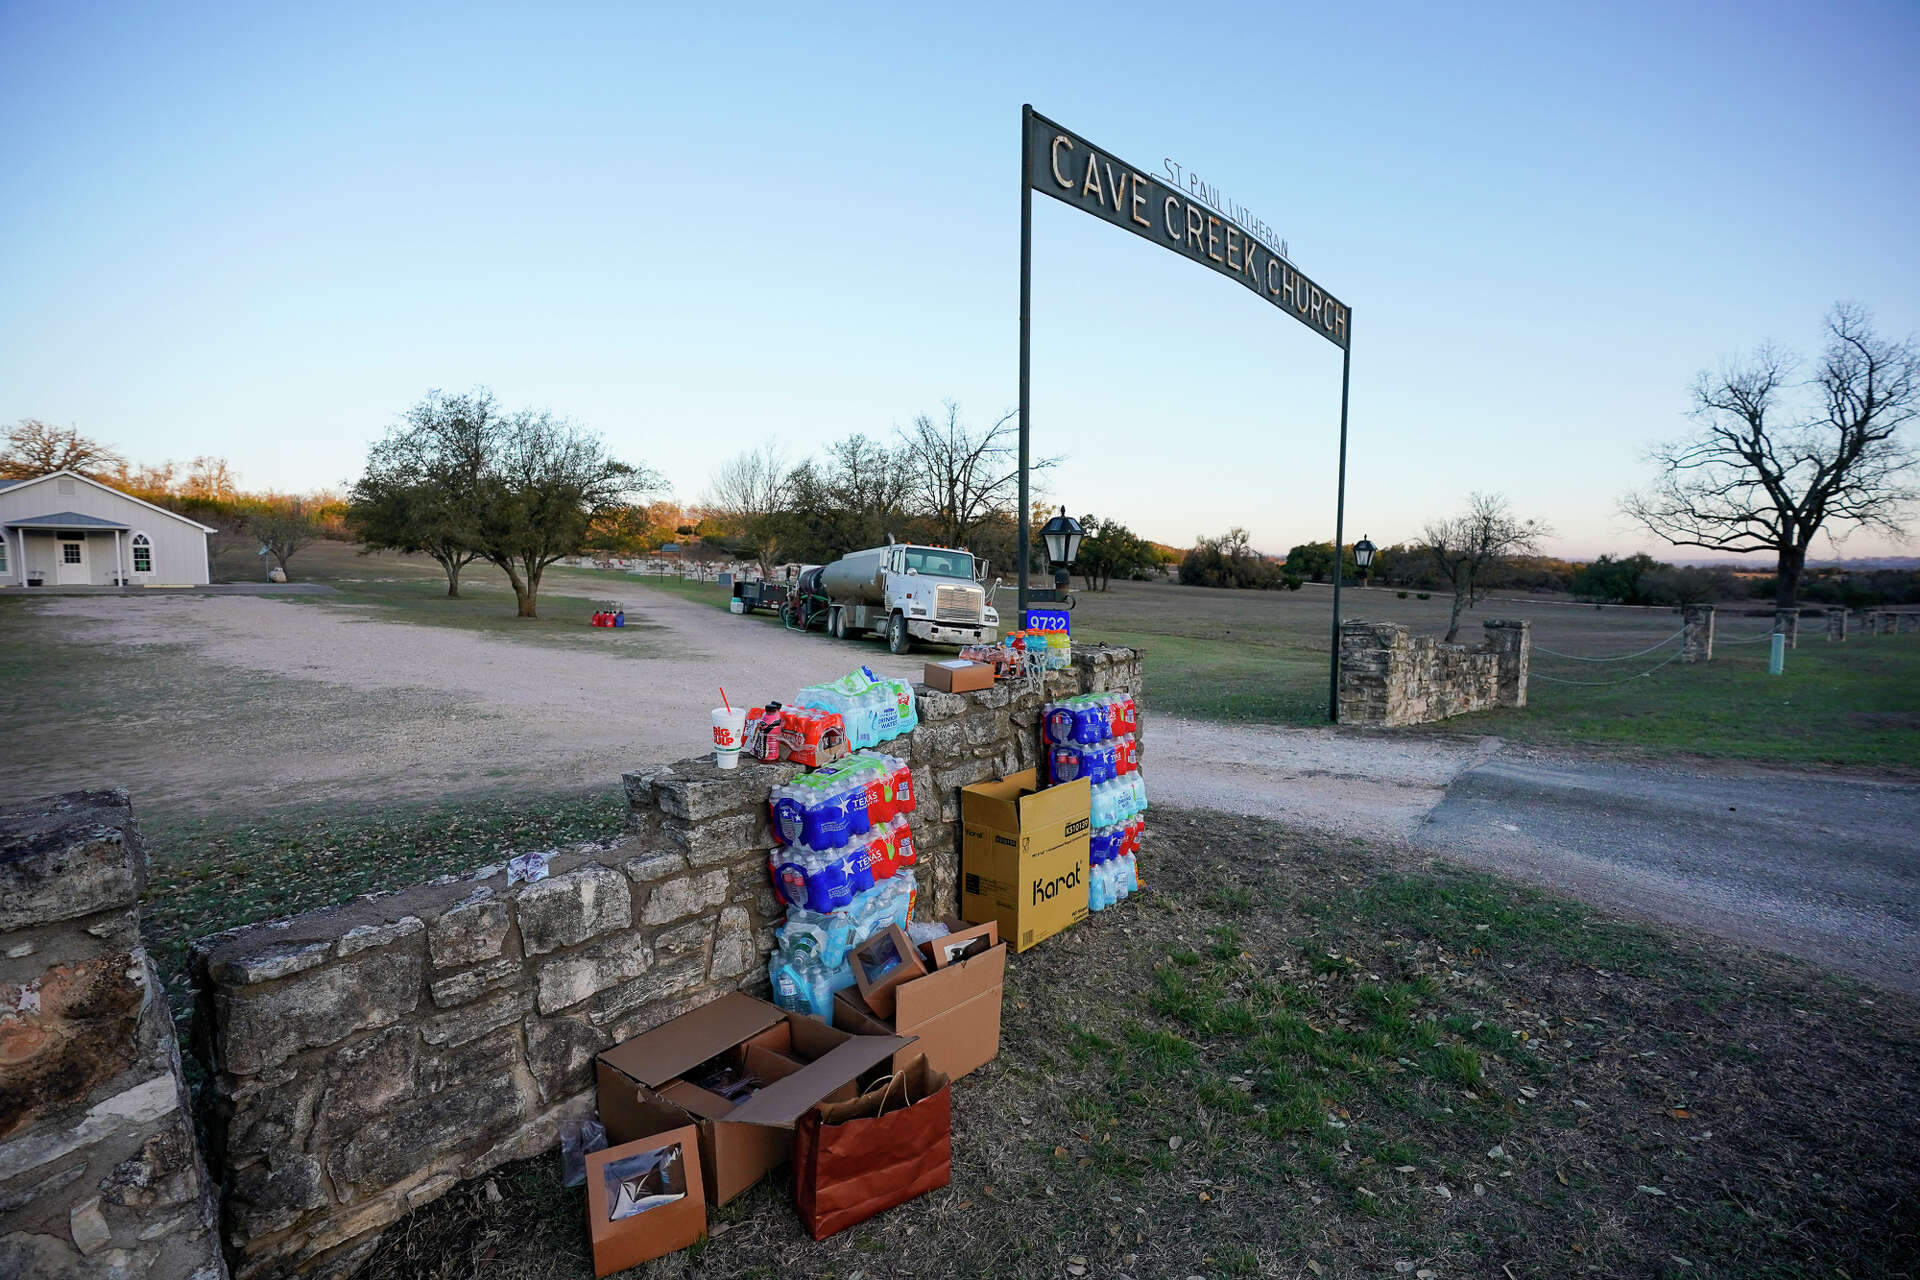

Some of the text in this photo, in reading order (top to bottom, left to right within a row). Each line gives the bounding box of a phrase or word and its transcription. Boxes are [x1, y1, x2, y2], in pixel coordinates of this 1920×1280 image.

[1164, 157, 1289, 258] ST PAUL LUTHERAN
[1051, 134, 1346, 340] CAVE CREEK CHURCH
[1030, 615, 1066, 630] 9732
[852, 791, 878, 808] TEXAS
[856, 849, 882, 868] TEXAS
[1032, 861, 1081, 906] Karat
